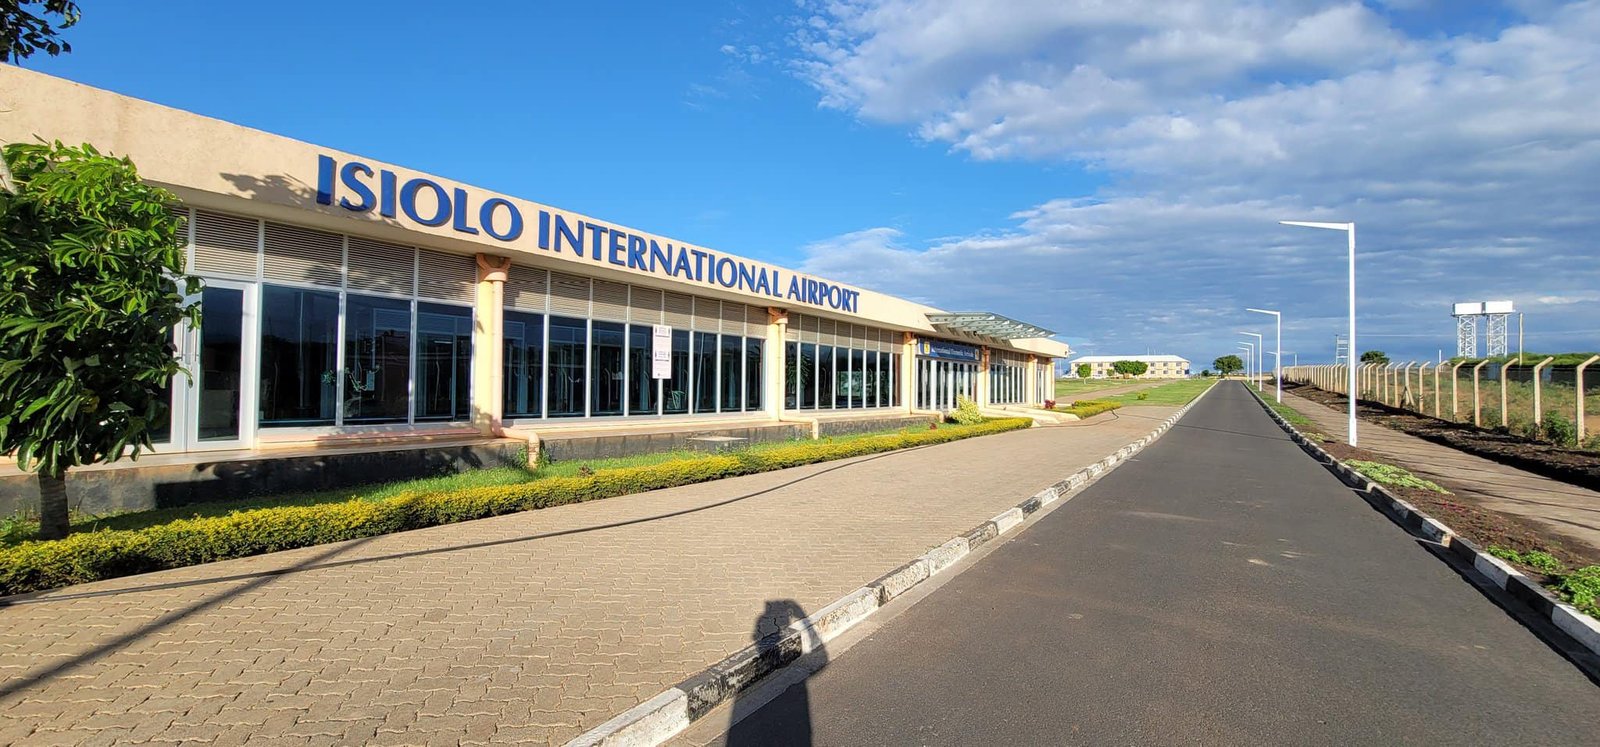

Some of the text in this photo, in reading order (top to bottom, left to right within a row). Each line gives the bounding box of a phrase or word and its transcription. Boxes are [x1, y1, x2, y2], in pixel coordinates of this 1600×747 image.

[316, 154, 860, 313] ISIOLO INTERNATIONAL AIRPORT
